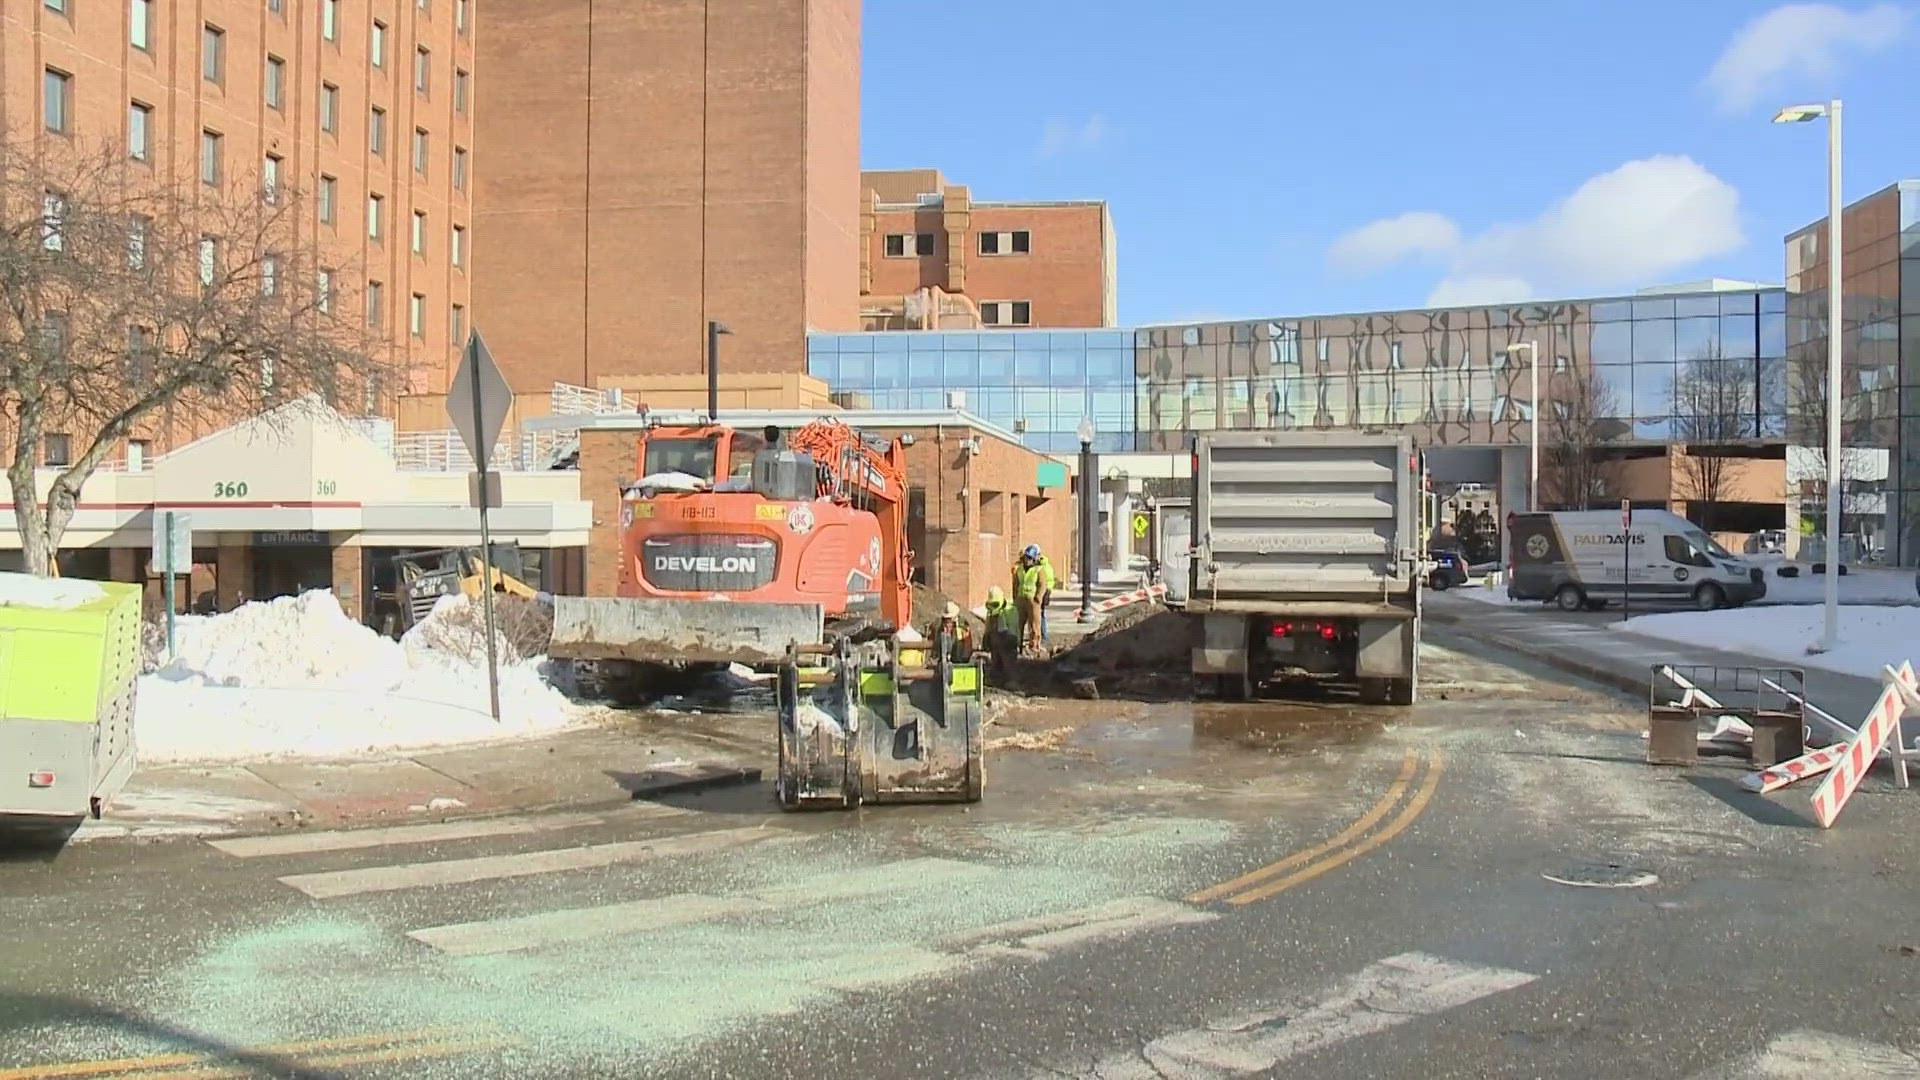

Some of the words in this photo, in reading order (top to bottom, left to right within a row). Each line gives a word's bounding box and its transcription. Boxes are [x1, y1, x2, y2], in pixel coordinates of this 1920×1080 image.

[214, 481, 248, 497] 360
[317, 481, 336, 495] 360
[261, 532, 320, 543] ENTRANCE
[655, 557, 756, 573] DEVELON
